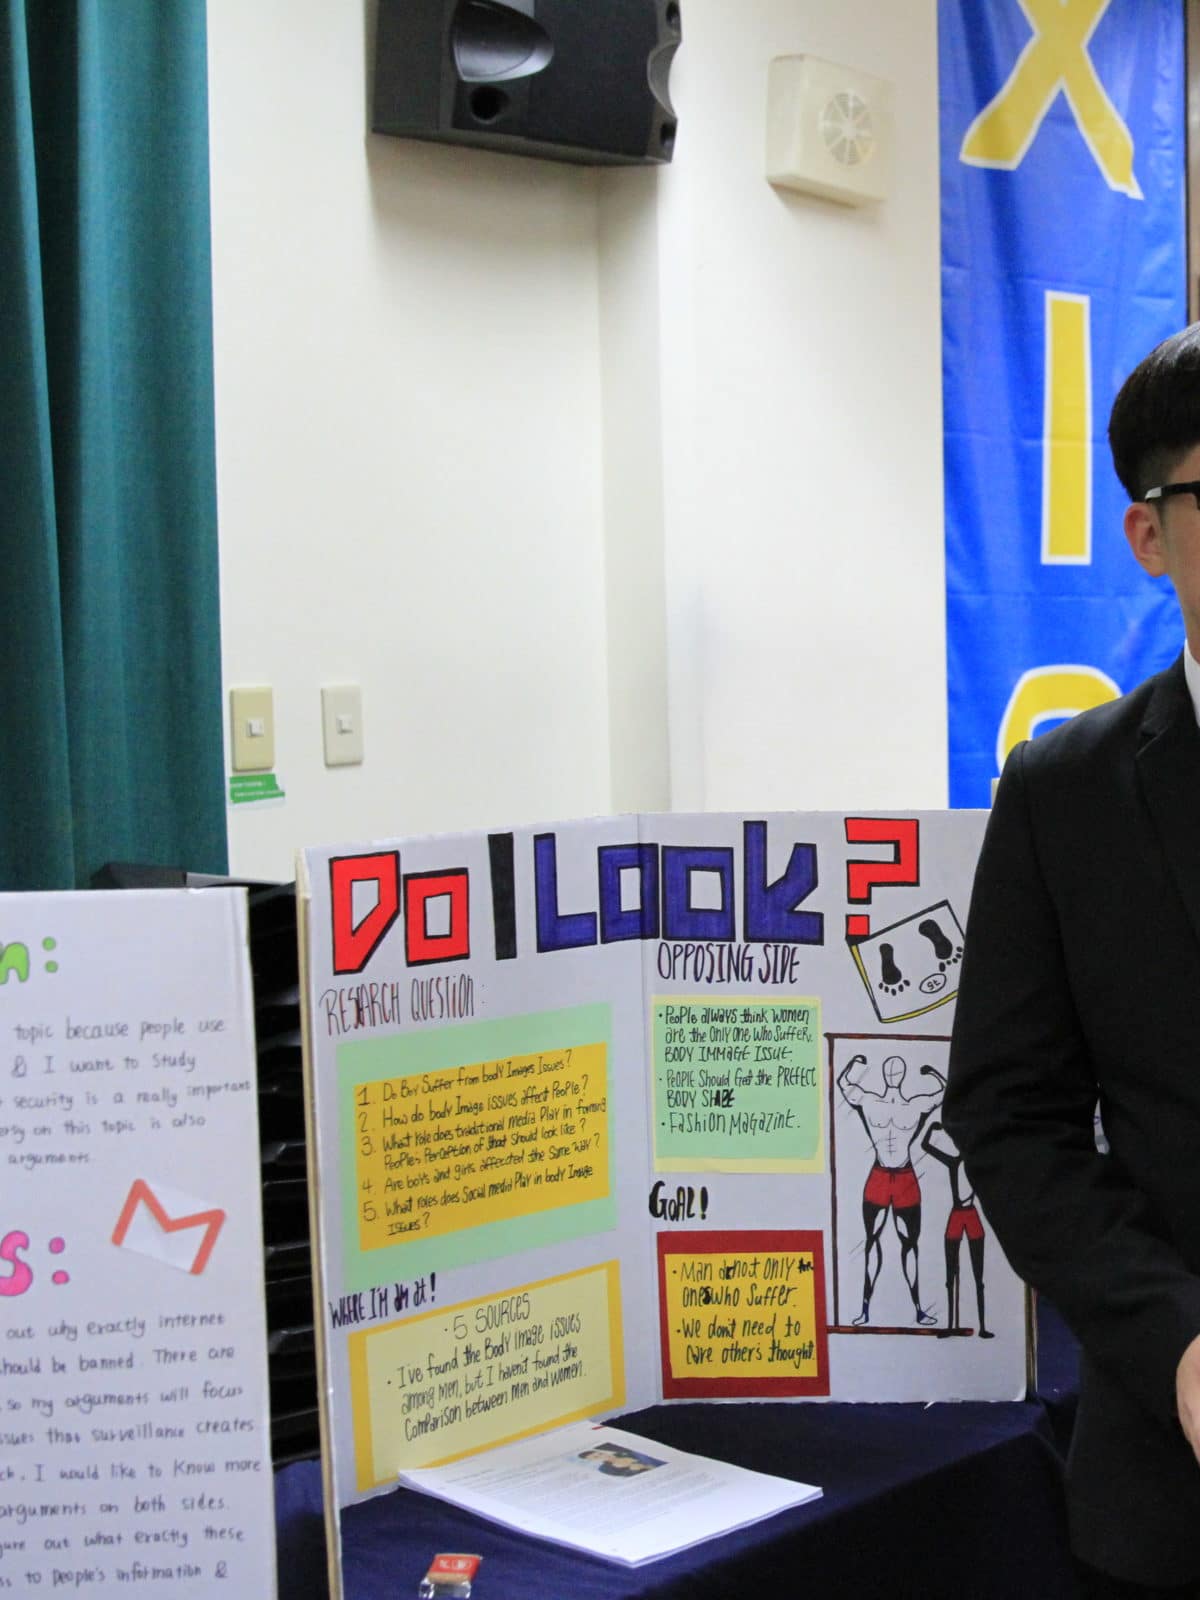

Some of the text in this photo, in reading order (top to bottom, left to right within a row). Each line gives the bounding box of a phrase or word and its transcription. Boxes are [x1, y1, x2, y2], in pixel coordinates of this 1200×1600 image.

[657, 943, 800, 984] OPPOSING SIDE
[740, 1008, 768, 1023] think
[13, 1015, 226, 1046] topic because people use
[665, 1028, 685, 1043] are
[689, 1028, 706, 1041] the
[44, 1055, 54, 1074] I
[69, 1058, 113, 1072] want
[124, 1056, 139, 1070] to
[665, 1047, 694, 1062] BODY
[383, 1082, 397, 1101] Do
[457, 1066, 479, 1086] from
[755, 1071, 772, 1085] the
[14, 1080, 251, 1111] security is a really important
[667, 1090, 696, 1108] BODY
[33, 1127, 51, 1136] on
[63, 1120, 91, 1135] this
[101, 1120, 135, 1135] topic
[172, 1112, 206, 1128] also
[383, 1104, 408, 1128] How
[411, 1104, 424, 1122] do
[383, 1132, 412, 1152] What
[433, 1125, 453, 1142] does
[509, 1111, 535, 1129] media
[563, 1104, 572, 1119] in
[473, 1137, 485, 1153] of
[542, 1127, 558, 1139] look
[384, 1178, 404, 1194] Are
[433, 1166, 450, 1182] and
[528, 1148, 544, 1163] the
[385, 1196, 412, 1216] What
[534, 1172, 542, 1185] in
[680, 1262, 712, 1281] Man
[6, 1313, 225, 1342] out why exactly internet
[454, 1315, 468, 1340] 5
[742, 1314, 776, 1337] need
[785, 1316, 800, 1337] to
[52, 1346, 234, 1373] be There are
[426, 1345, 459, 1378] found
[463, 1343, 480, 1367] the
[402, 1387, 434, 1415] among
[465, 1369, 483, 1394] but
[487, 1366, 493, 1386] I
[532, 1350, 560, 1371] found
[563, 1342, 577, 1361] the
[32, 1398, 53, 1417] my
[64, 1392, 148, 1414] arguments
[160, 1386, 189, 1402] will
[202, 1380, 243, 1398] focus
[466, 1391, 507, 1418] between
[512, 1382, 529, 1400] men
[532, 1370, 548, 1392] and
[46, 1427, 80, 1444] that
[196, 1417, 254, 1432] creates
[35, 1459, 261, 1482] I would like to more
[100, 1504, 119, 1514] on
[134, 1493, 166, 1512] both
[44, 1525, 246, 1550] out what exactly these
[25, 1571, 41, 1584] to
[115, 1560, 201, 1582] information
